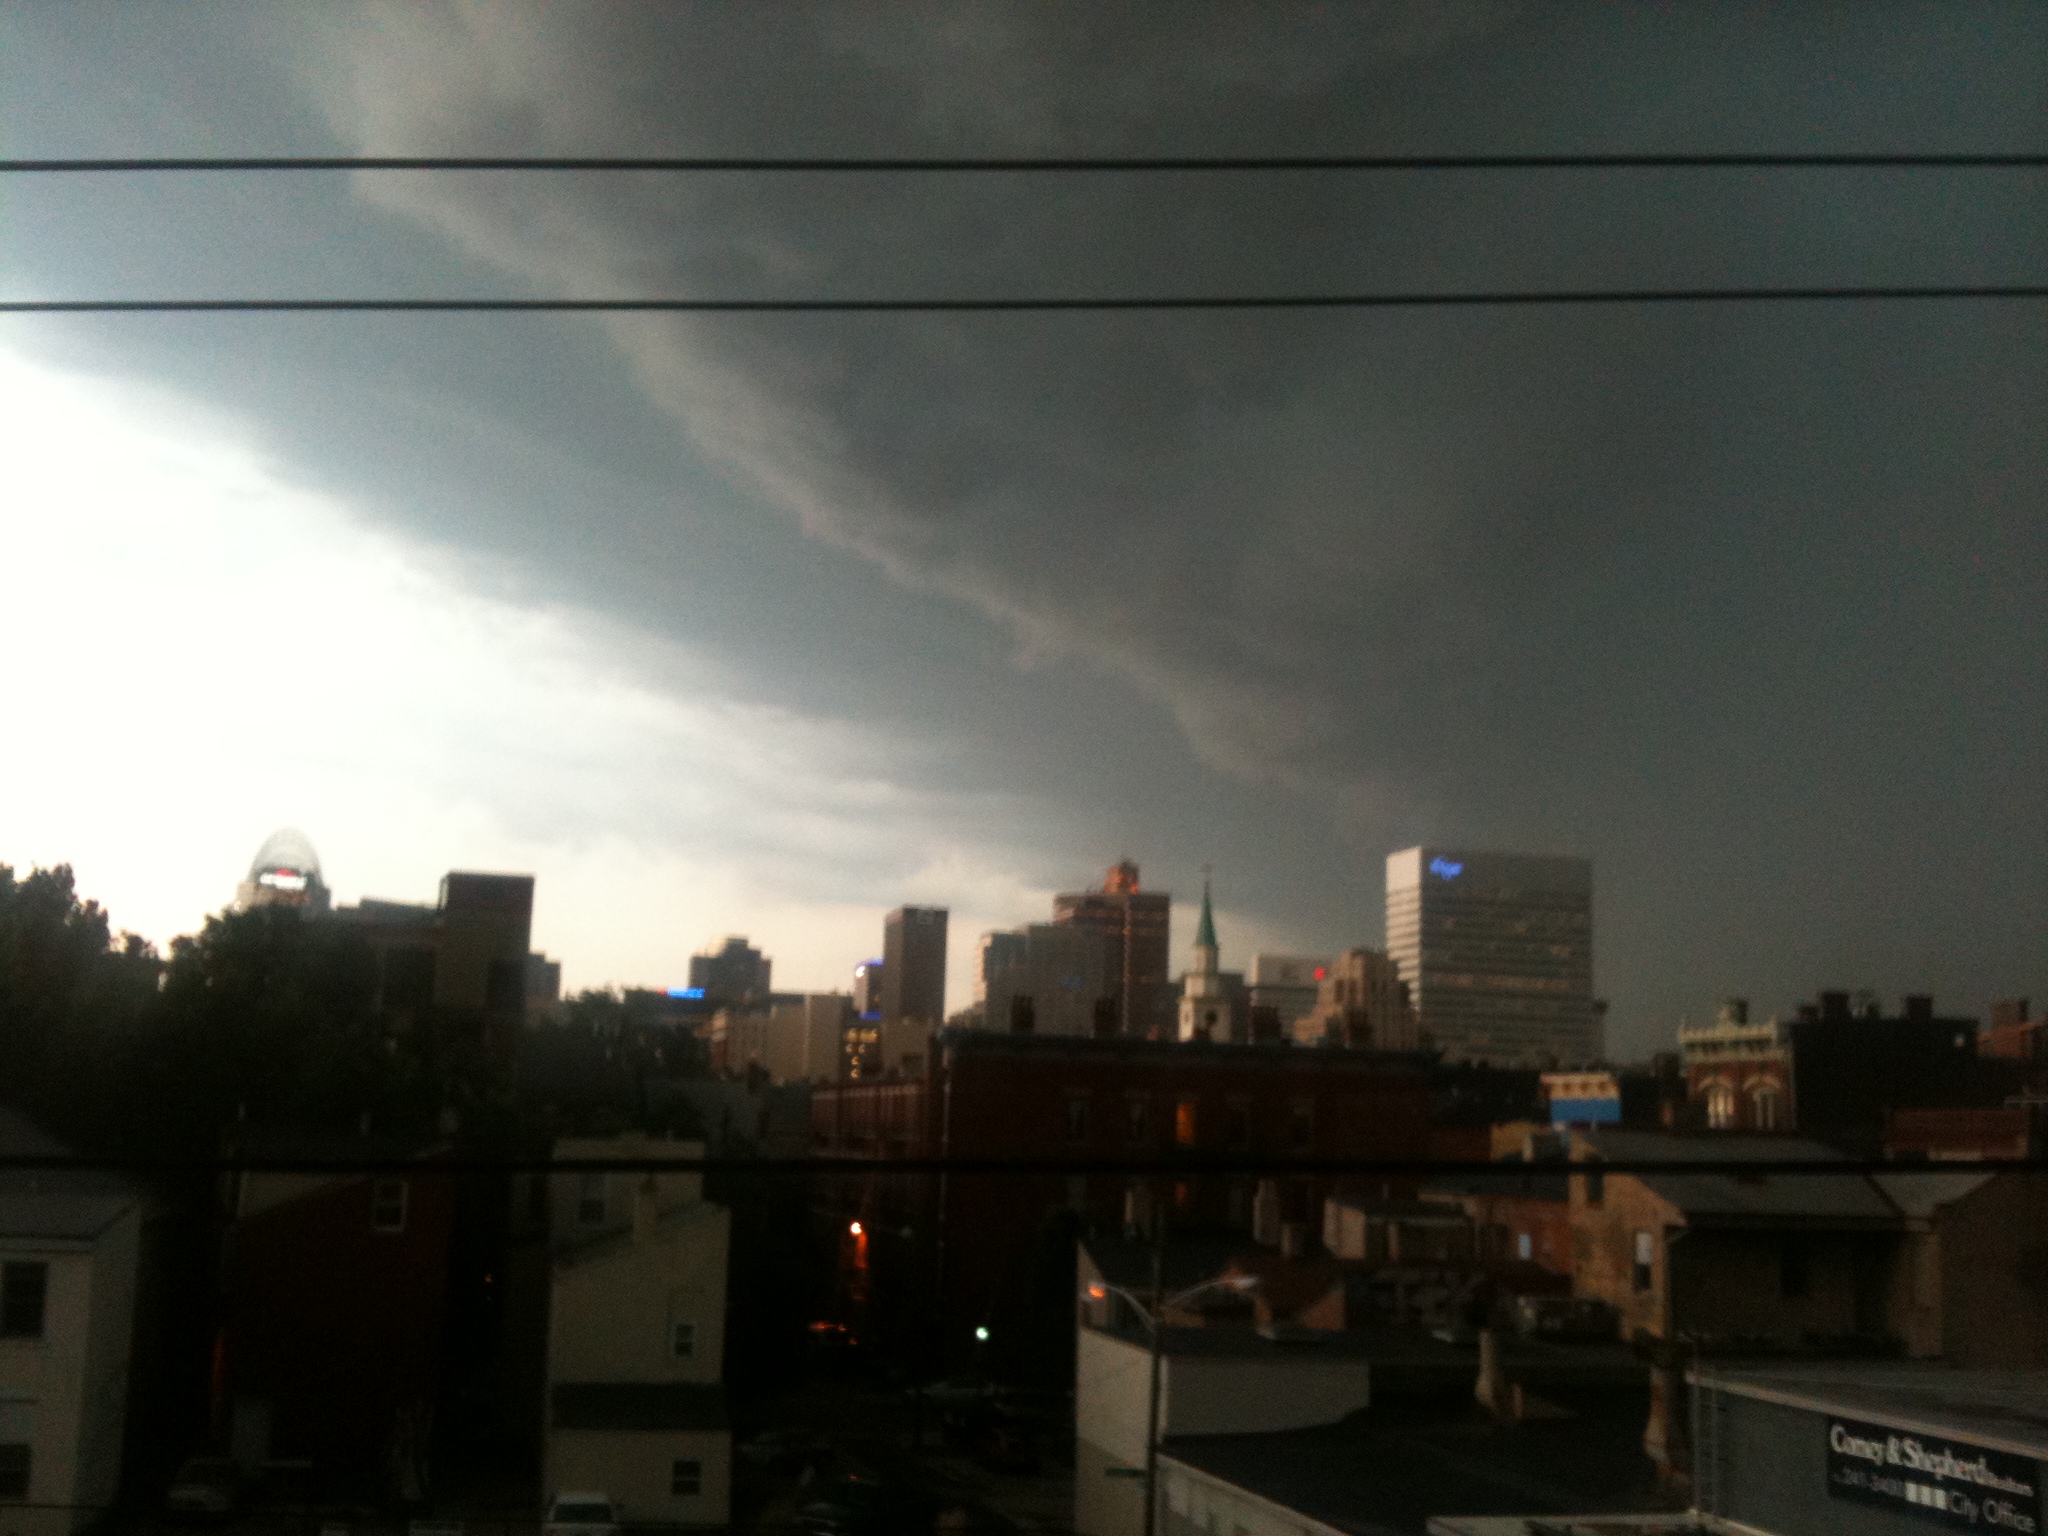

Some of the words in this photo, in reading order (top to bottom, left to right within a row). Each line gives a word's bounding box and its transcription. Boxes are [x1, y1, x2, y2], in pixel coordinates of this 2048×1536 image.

[1886, 1435, 1901, 1465] &
[1947, 1490, 1979, 1523] City
[1983, 1498, 2035, 1533] Office
